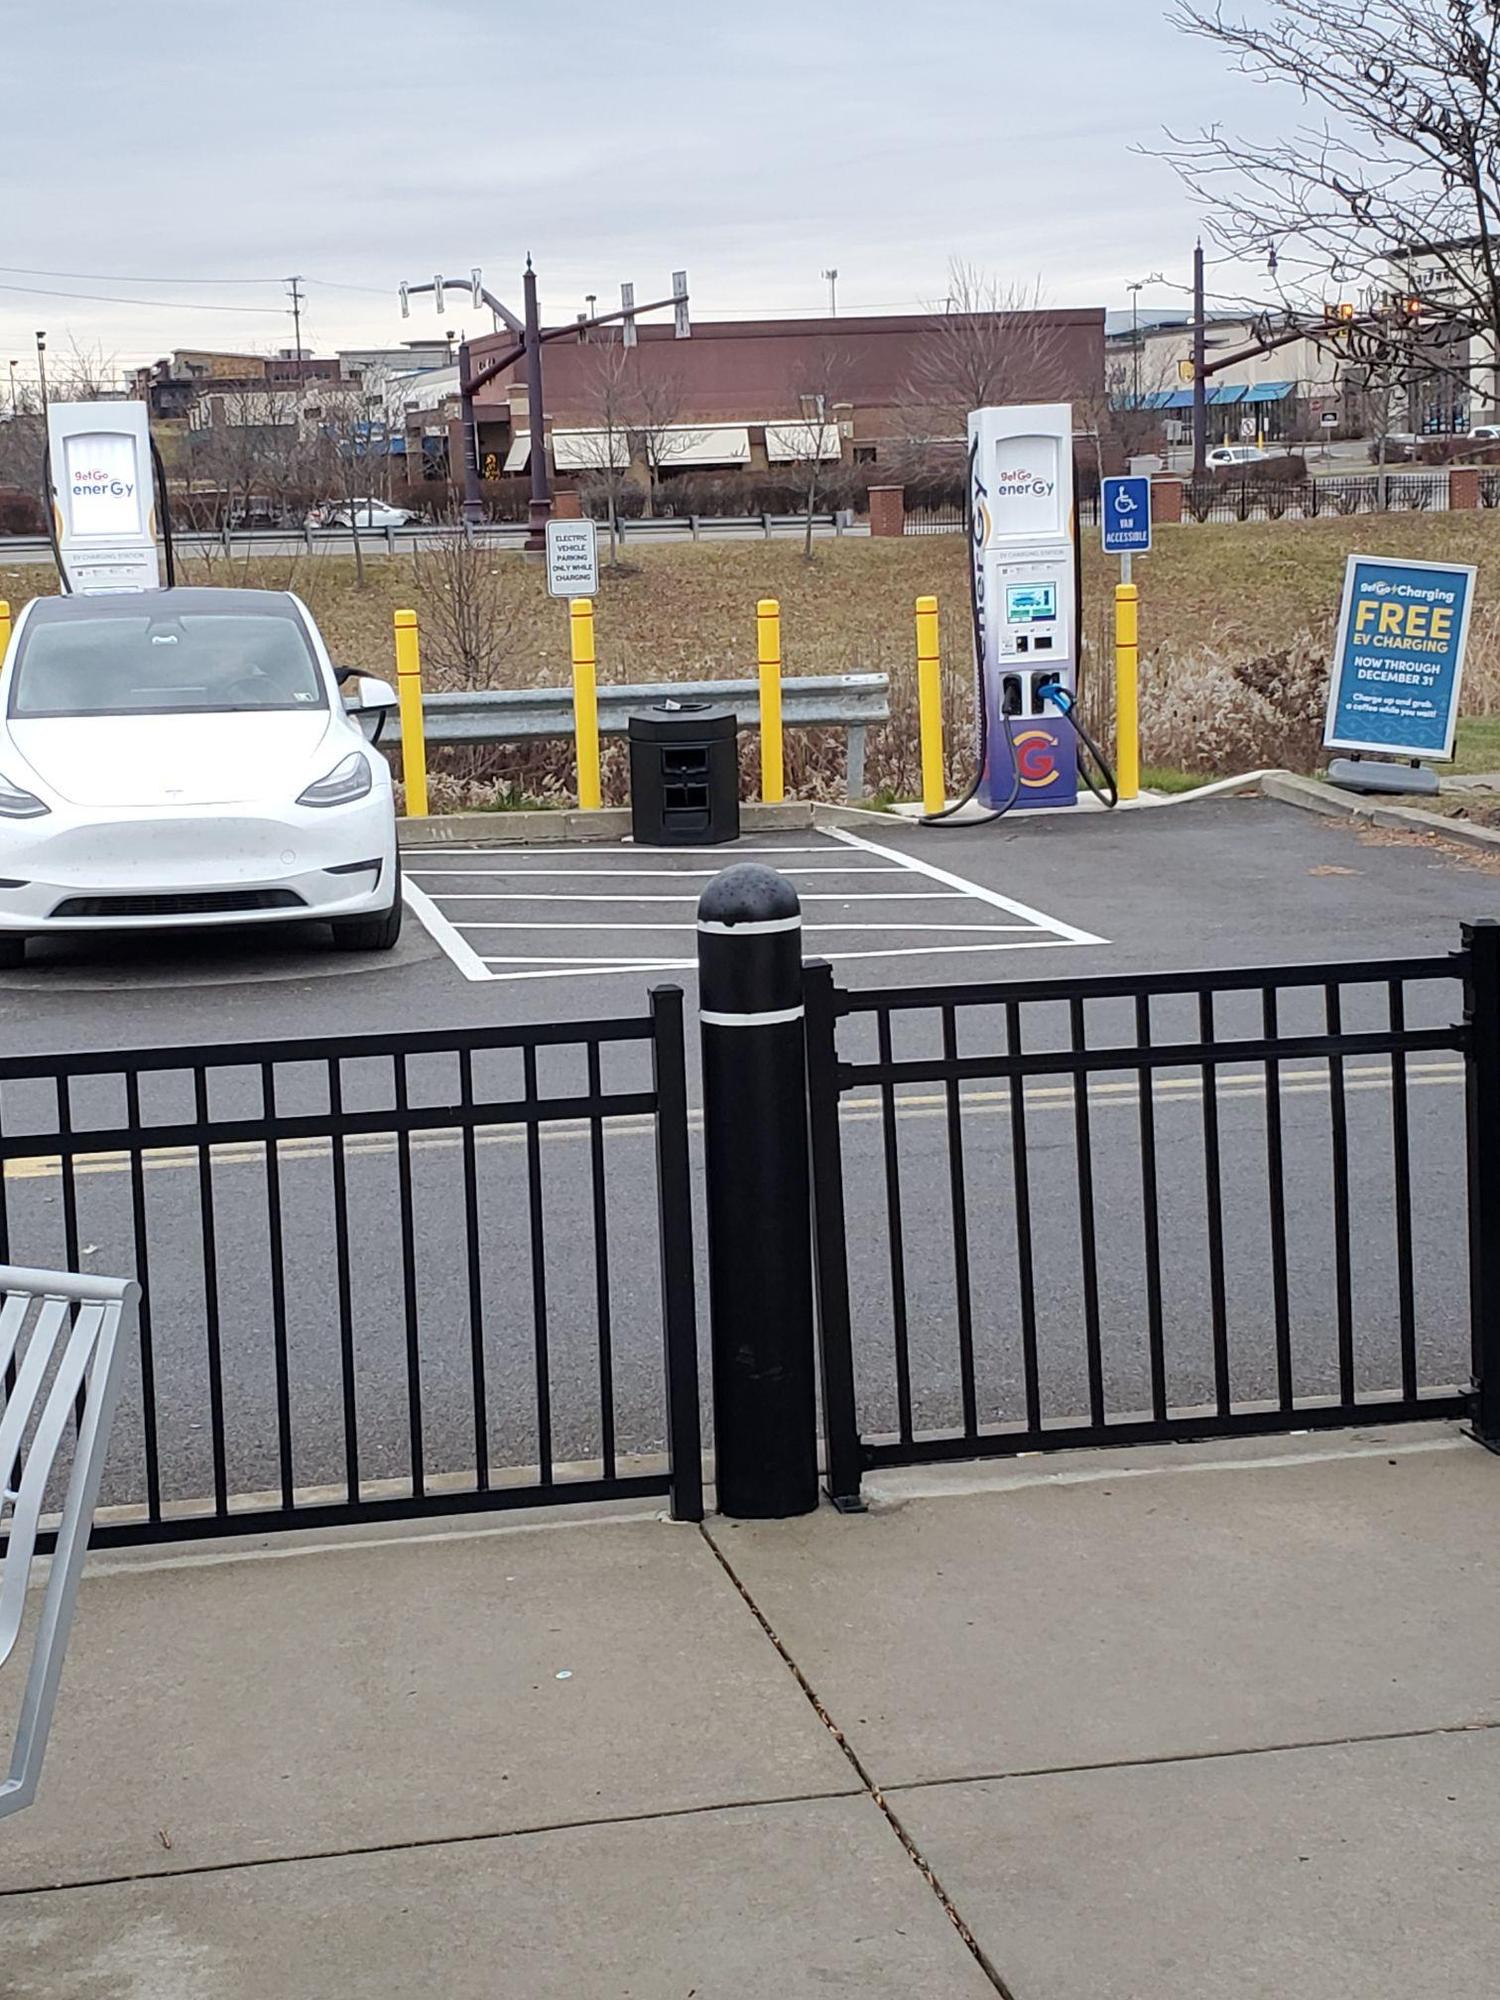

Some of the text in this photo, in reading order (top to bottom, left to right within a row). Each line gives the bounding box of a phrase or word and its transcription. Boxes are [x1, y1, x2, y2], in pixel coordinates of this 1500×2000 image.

[72, 480, 134, 498] enerGy
[998, 479, 1054, 497] enerGy
[1119, 518, 1134, 529] VAN
[555, 534, 588, 542] ELECTRIC
[1106, 531, 1148, 543] ACCESSIBLE
[557, 544, 586, 552] VEHICLE
[557, 554, 588, 562] PARKING
[552, 563, 593, 572] ONLY WHILE
[555, 573, 591, 582] CHARGING
[1397, 585, 1455, 604] Charging
[1355, 600, 1454, 640] FREE
[1353, 633, 1449, 654] EV CHARGING
[1354, 656, 1441, 675] NOW THROUGH
[1357, 669, 1434, 686] DECEMBER 31
[1352, 693, 1433, 709] Charge up and grab
[1353, 703, 1378, 712] coffee
[1379, 706, 1400, 715] while
[1400, 709, 1416, 717] you
[1017, 739, 1054, 778] G
